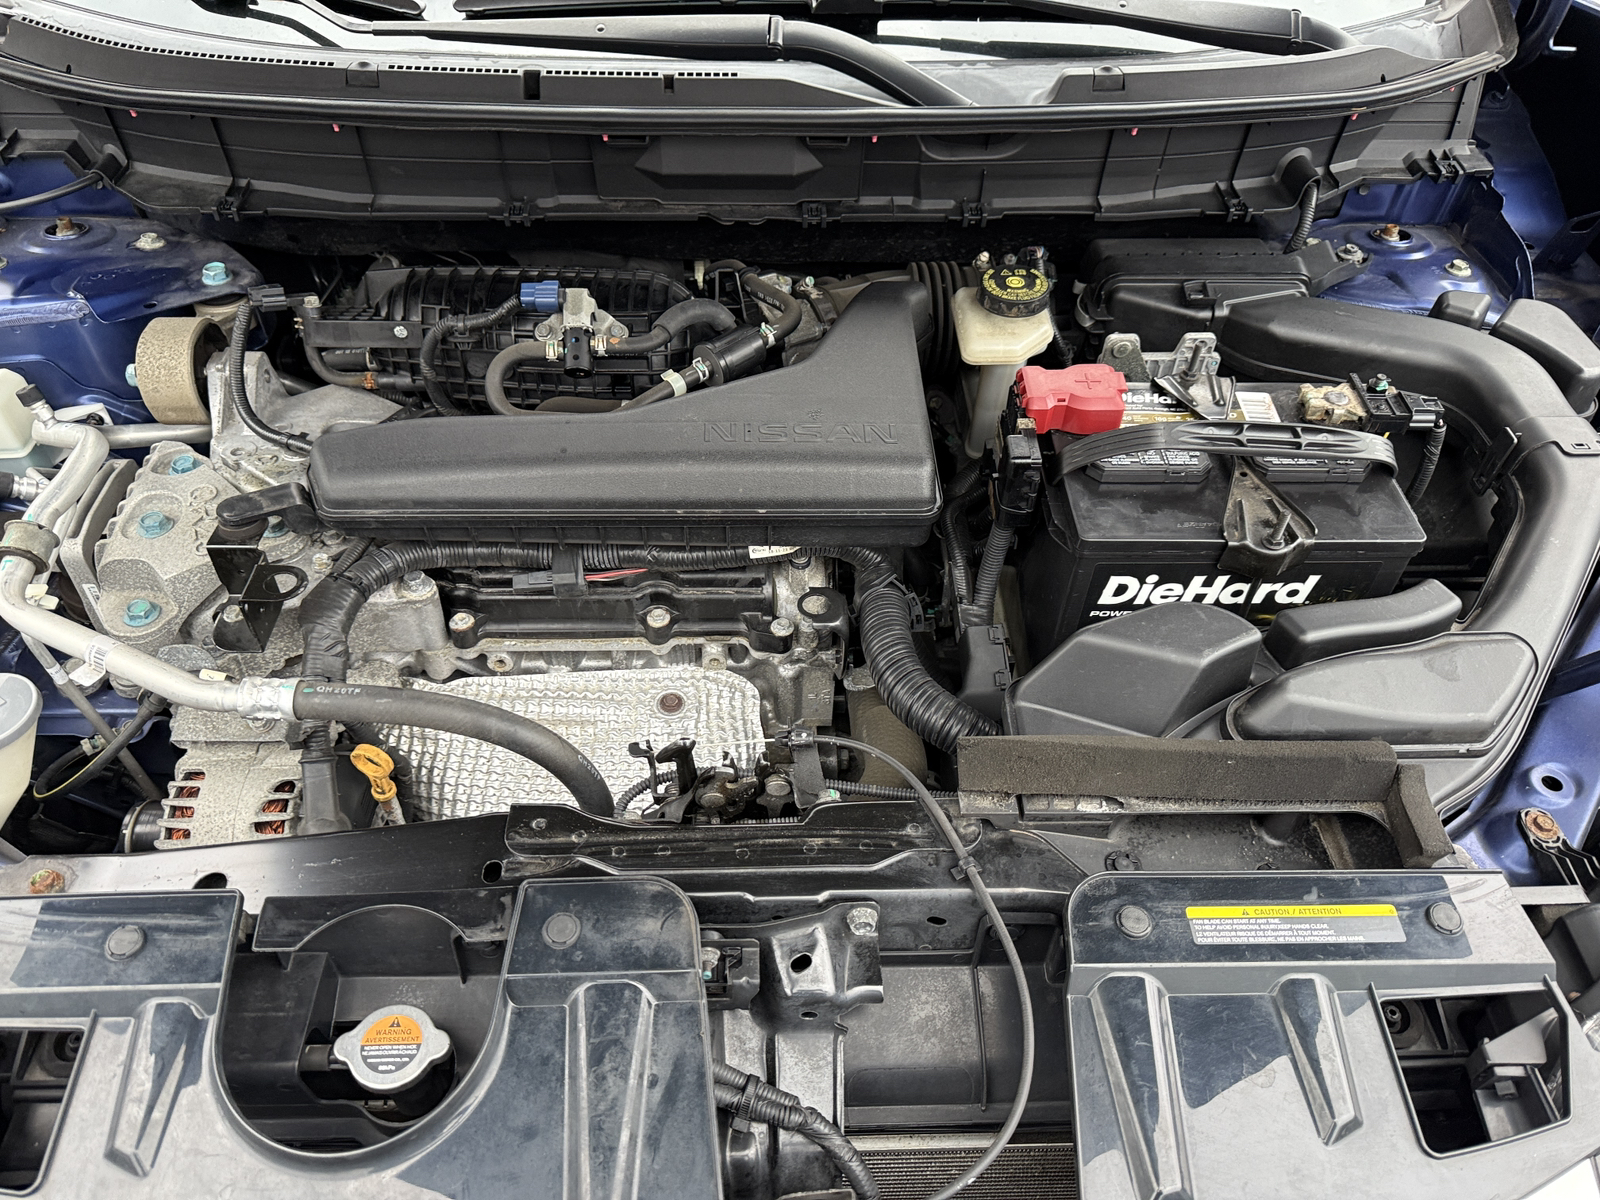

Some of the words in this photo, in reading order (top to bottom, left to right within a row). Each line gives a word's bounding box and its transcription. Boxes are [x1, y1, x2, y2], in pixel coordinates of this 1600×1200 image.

[1122, 392, 1177, 404] ieHa
[704, 422, 898, 444] NISSAN
[1097, 574, 1322, 604] DieHard
